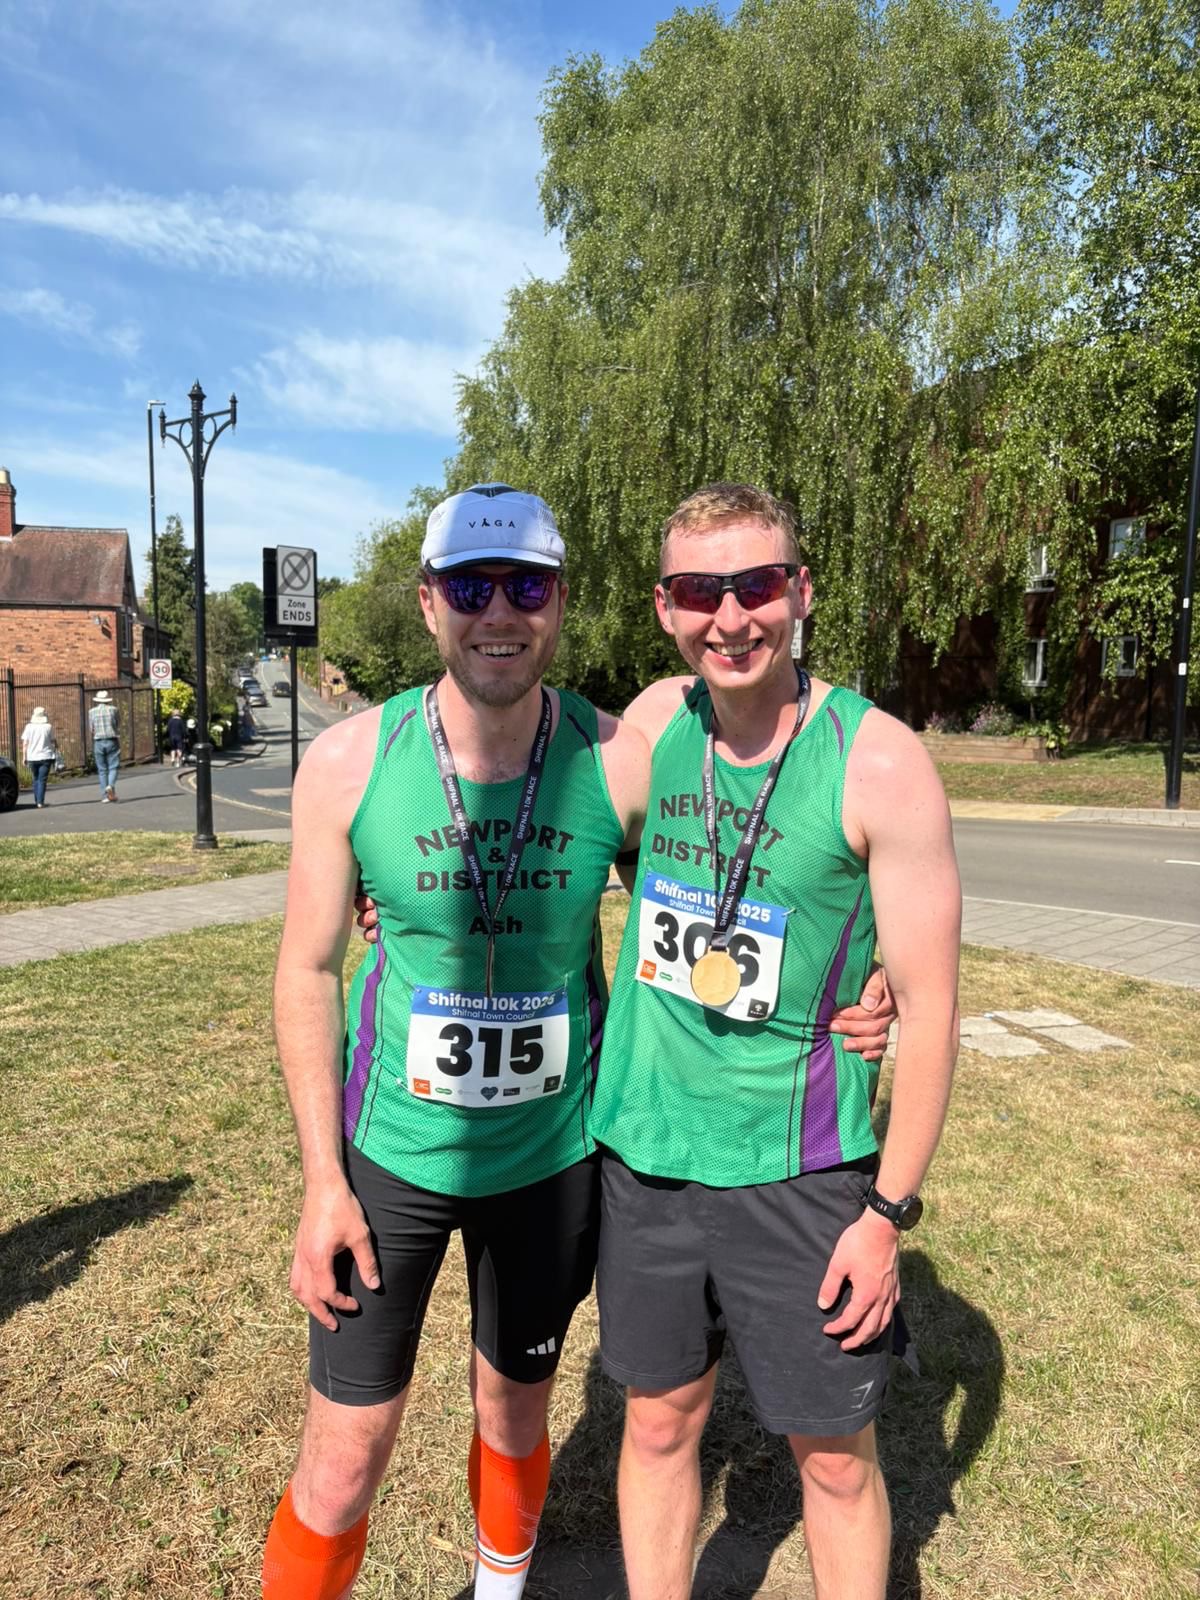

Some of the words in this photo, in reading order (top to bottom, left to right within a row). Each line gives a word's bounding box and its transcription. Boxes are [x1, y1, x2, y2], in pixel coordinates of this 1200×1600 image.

[287, 599, 306, 608] Zone
[282, 610, 312, 622] ENDS
[155, 665, 168, 674] 30
[534, 735, 547, 763] SHIFNAL
[446, 776, 459, 808] SHIFNAL
[527, 776, 538, 796] RACE
[524, 794, 533, 808] 10K
[454, 808, 465, 822] 10K
[517, 810, 529, 839] SHIFNAL
[744, 813, 759, 845] SHIFNAL
[755, 796, 764, 811] 10K
[459, 820, 469, 841] RACE
[487, 847, 506, 864] &
[509, 853, 519, 874] RACE
[467, 854, 481, 885] SHIFNAL
[478, 887, 487, 901] 10K
[732, 859, 745, 879] RACE
[505, 873, 514, 887] 10K
[729, 879, 738, 893] 10K
[654, 880, 701, 904] Shifnal
[669, 899, 695, 912] Shifnal
[696, 905, 716, 917] Town
[720, 895, 735, 926] SHIFNAL
[469, 916, 523, 936] Ash
[428, 992, 488, 1010] Shifnal
[491, 998, 518, 1011] 10k
[452, 1008, 481, 1019] Shifnal
[482, 1011, 505, 1021] Town
[506, 1011, 536, 1021] Council
[436, 1022, 544, 1078] 315
